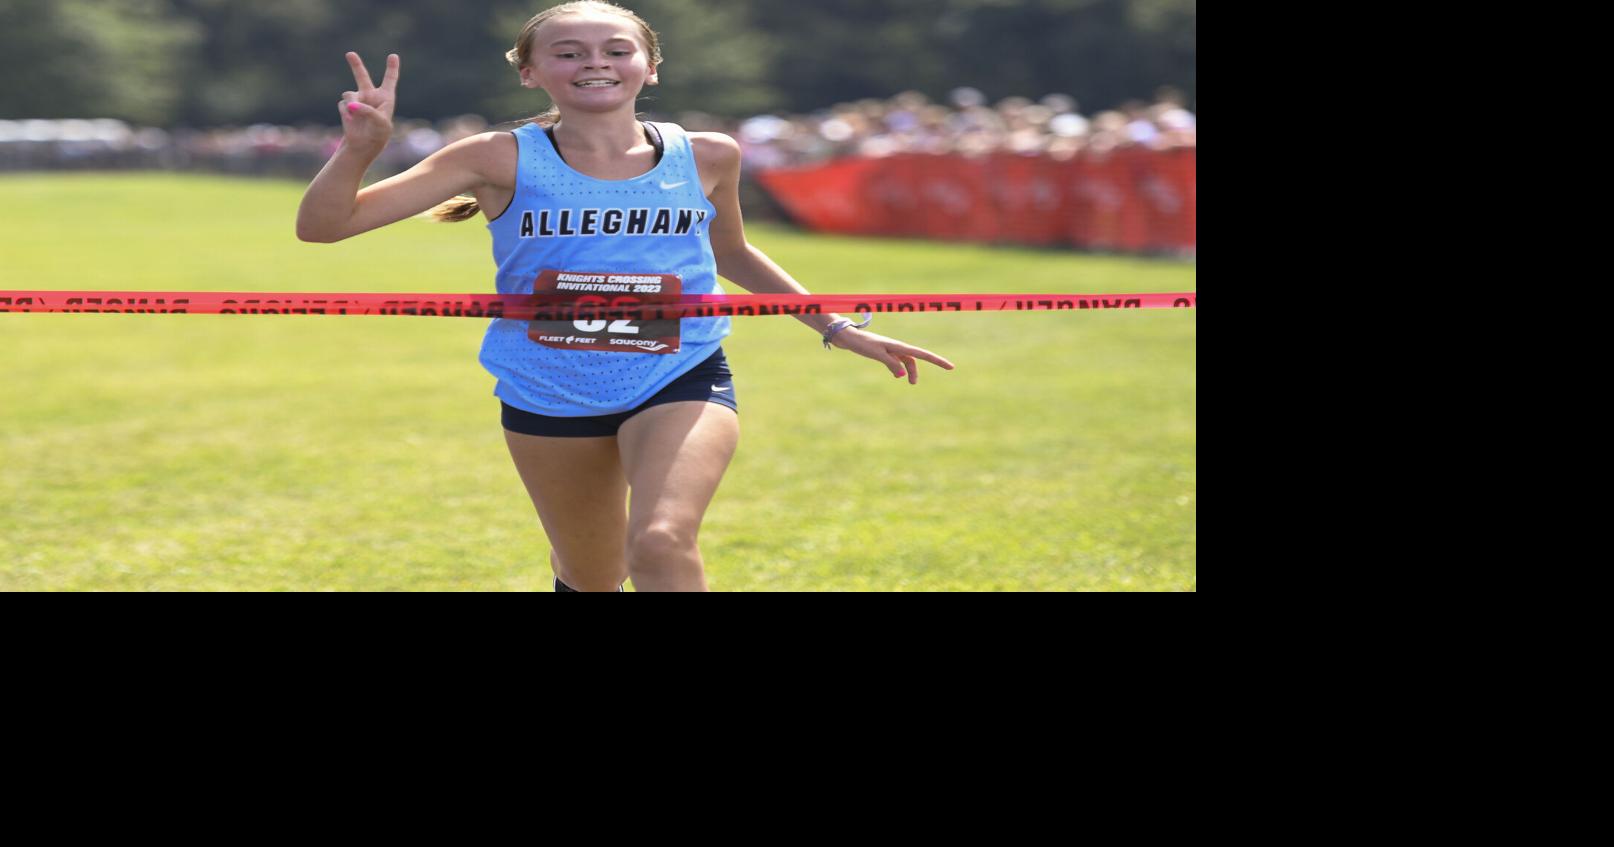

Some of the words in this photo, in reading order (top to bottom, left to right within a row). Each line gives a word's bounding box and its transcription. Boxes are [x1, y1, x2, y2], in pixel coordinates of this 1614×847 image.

[519, 208, 707, 238] ALLEGHANY
[557, 273, 605, 284] KNIGHTS
[607, 275, 662, 284] CROSSING
[557, 282, 630, 292] INVITATIONAL
[633, 284, 661, 293] 2023
[539, 335, 565, 343] FLEET
